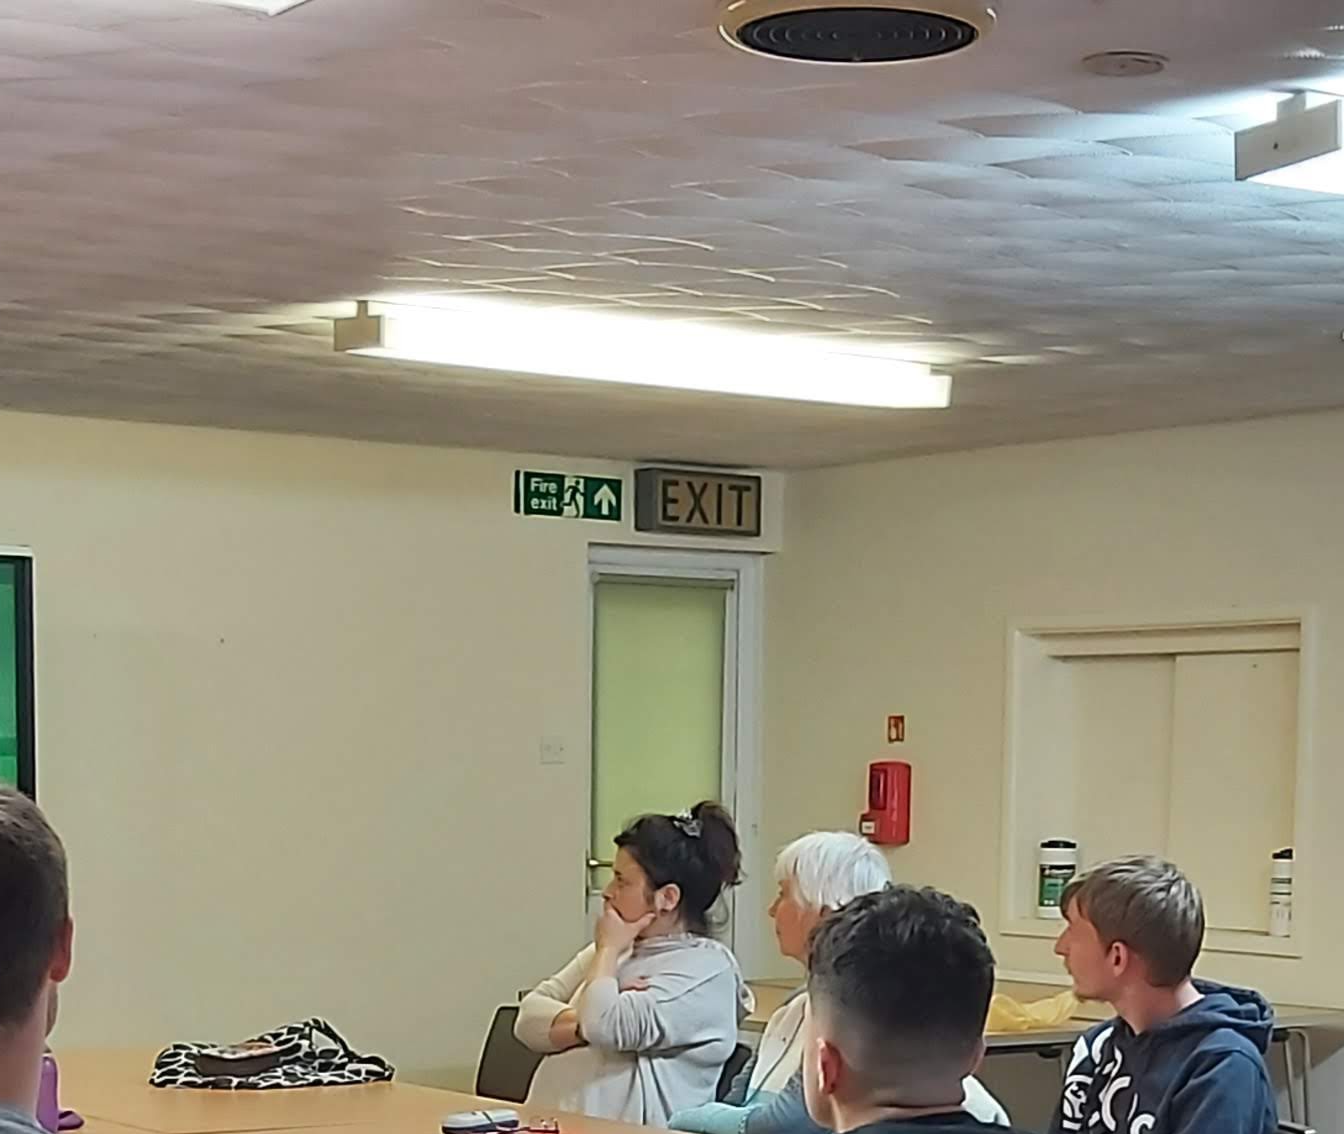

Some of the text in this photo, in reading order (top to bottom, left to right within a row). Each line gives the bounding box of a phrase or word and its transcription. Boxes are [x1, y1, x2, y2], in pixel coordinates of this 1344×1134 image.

[530, 478, 558, 494] Fire
[530, 496, 558, 511] exit
[660, 479, 752, 527] EXIT
